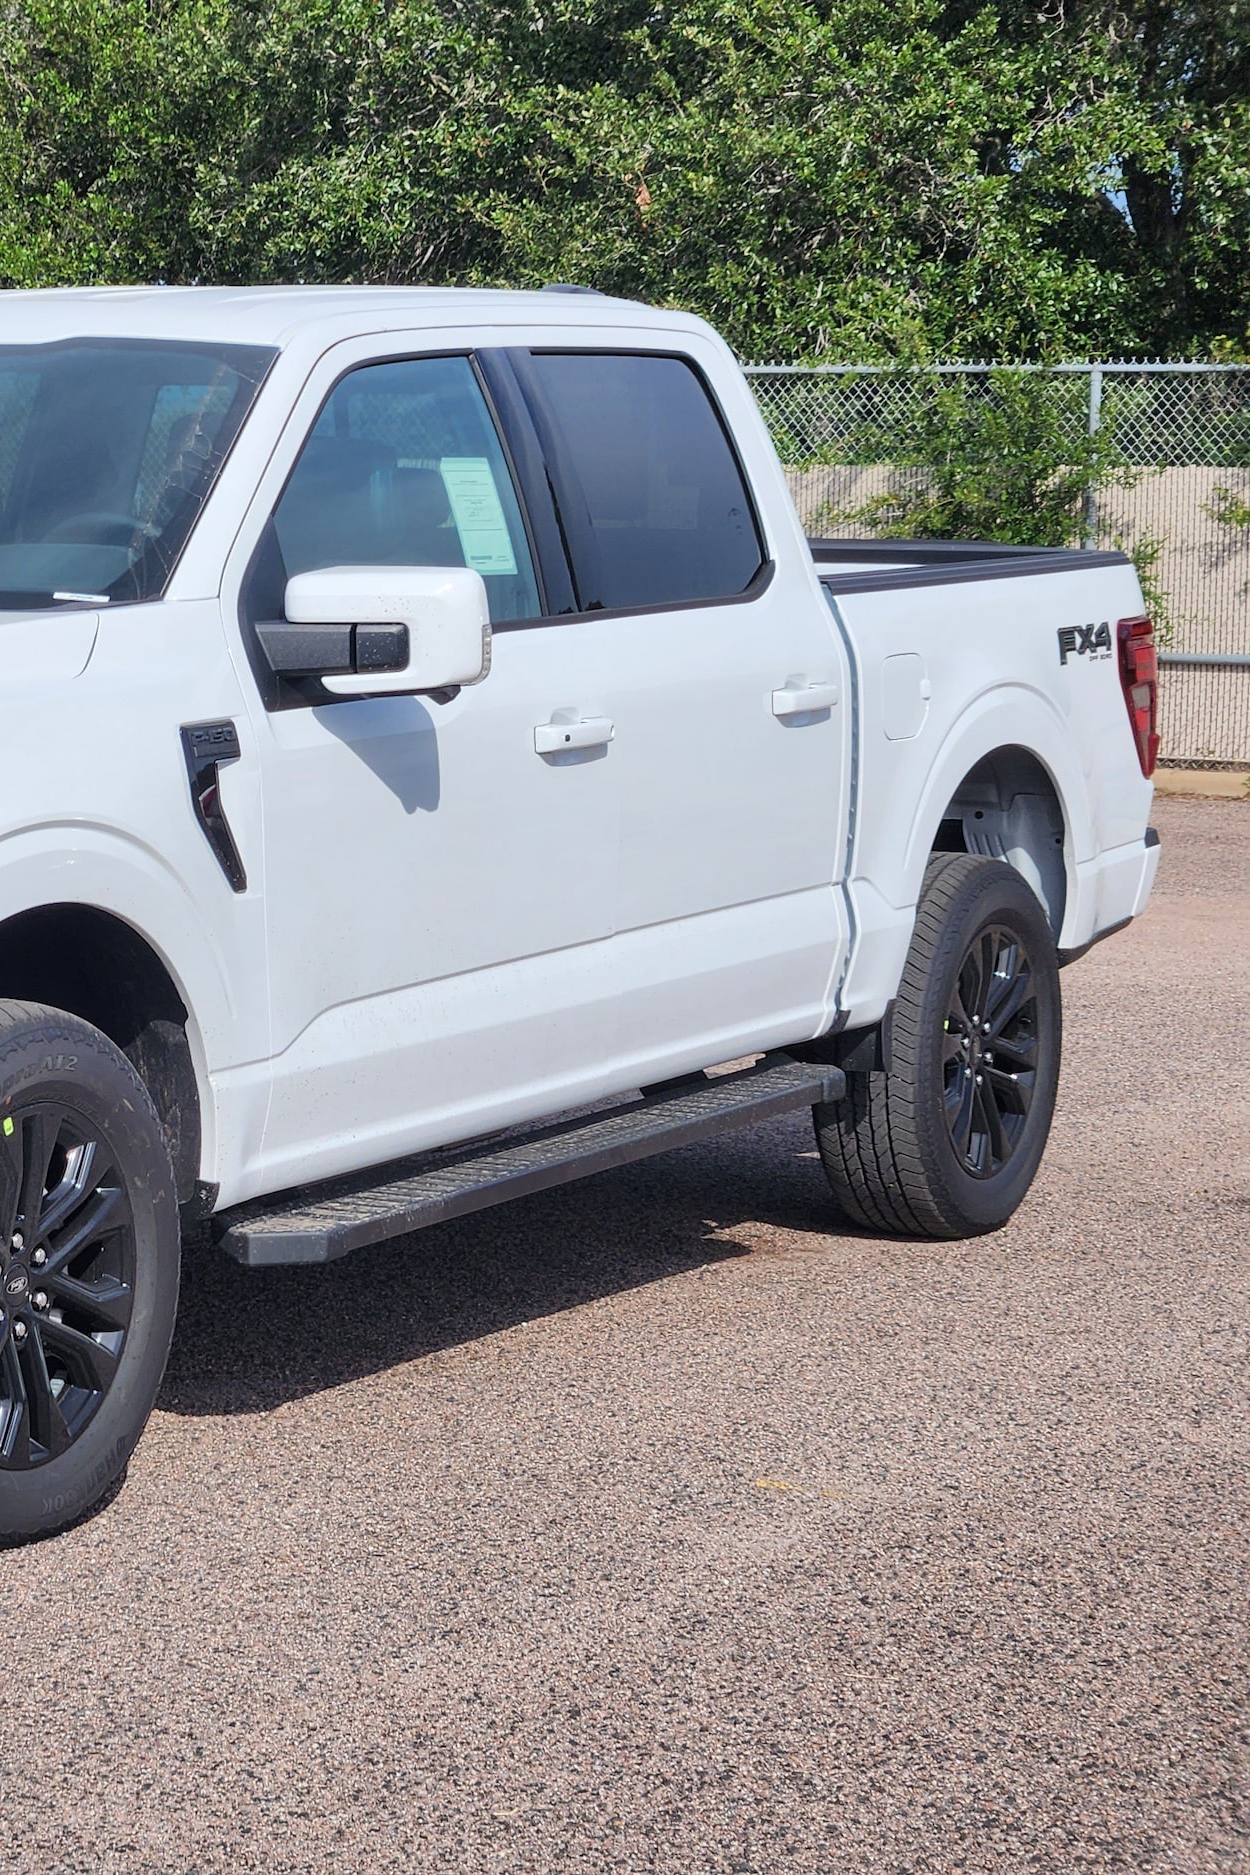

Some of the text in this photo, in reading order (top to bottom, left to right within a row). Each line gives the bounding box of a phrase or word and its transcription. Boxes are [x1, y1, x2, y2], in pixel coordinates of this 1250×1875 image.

[1057, 622, 1112, 666] FX4
[191, 726, 236, 744] F-150
[42, 1054, 79, 1072] AT2
